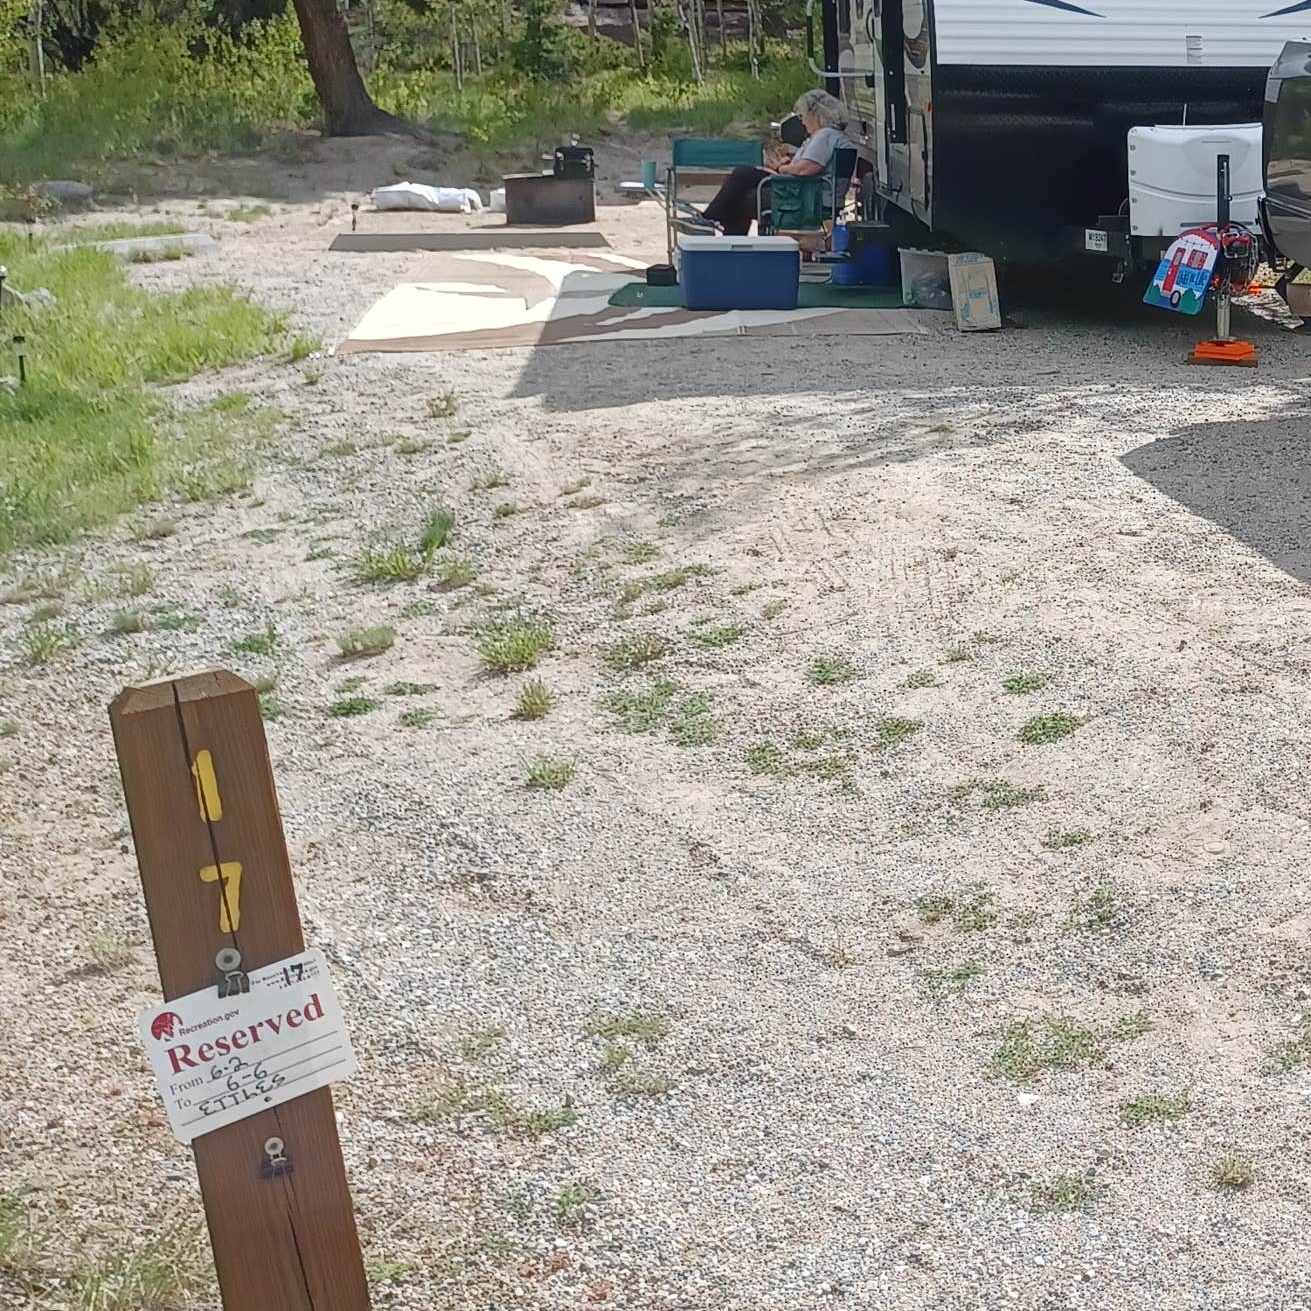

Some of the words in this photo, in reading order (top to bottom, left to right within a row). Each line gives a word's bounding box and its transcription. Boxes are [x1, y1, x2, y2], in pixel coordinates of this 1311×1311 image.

[283, 962, 303, 986] 17
[165, 993, 325, 1075] Reserved
[178, 1009, 240, 1037] Recreation.gov
[170, 1076, 204, 1096] From
[175, 1098, 192, 1111] To
